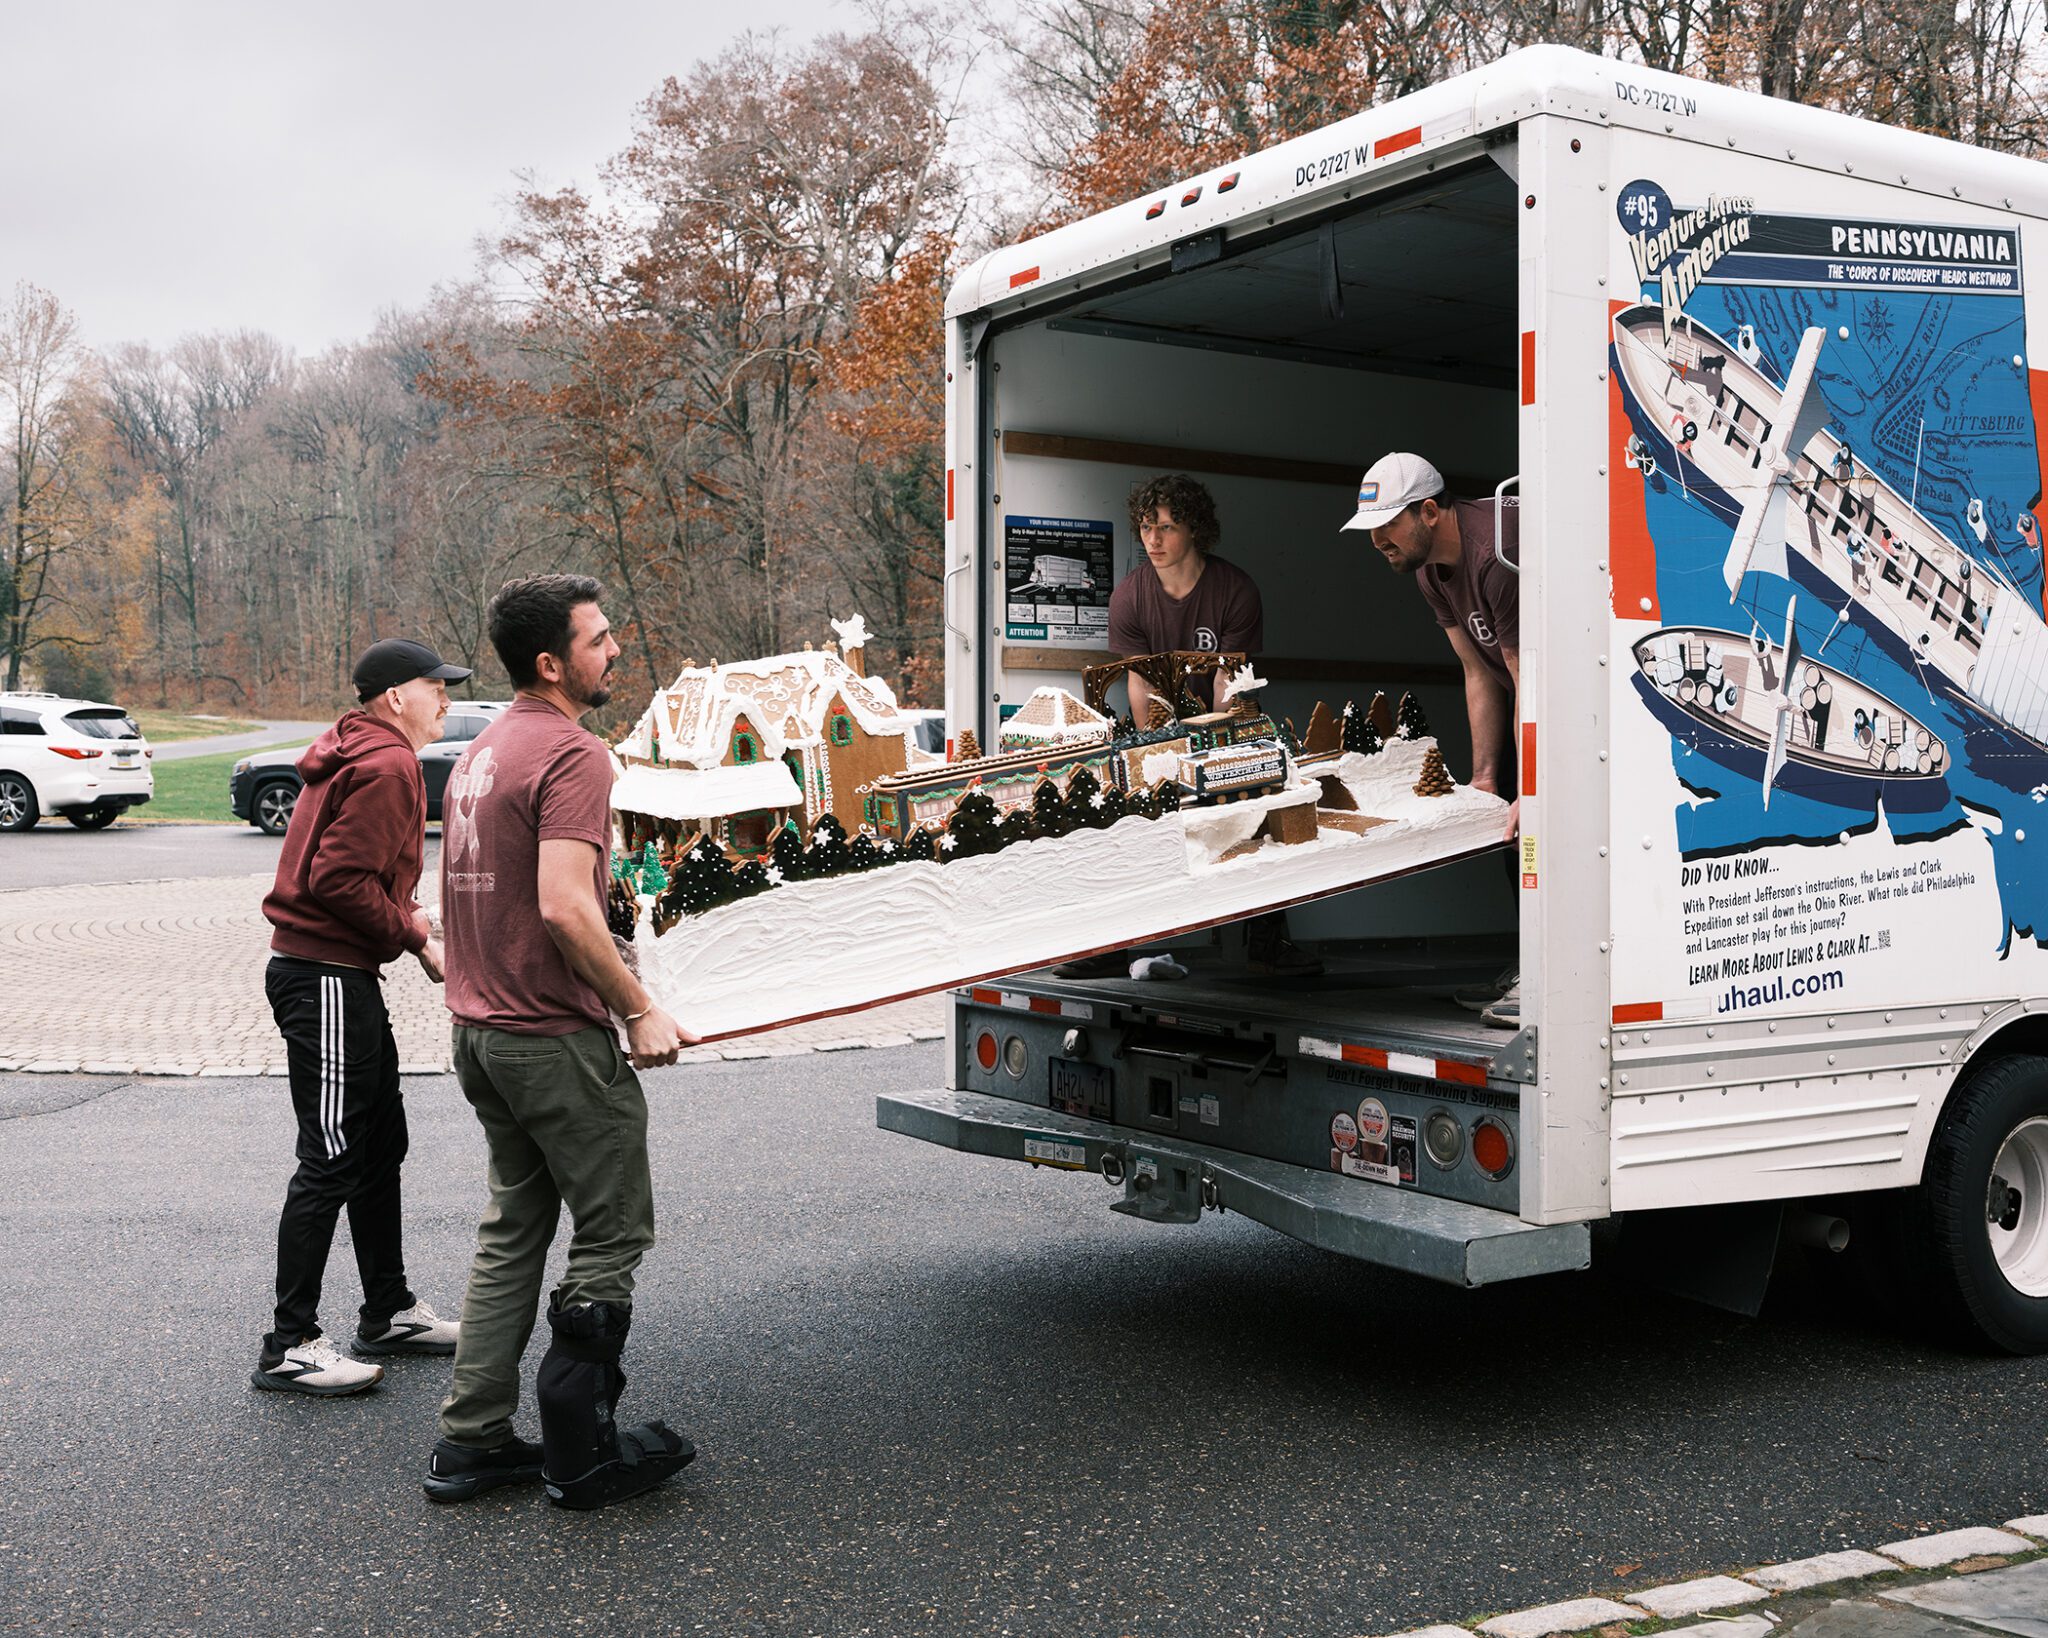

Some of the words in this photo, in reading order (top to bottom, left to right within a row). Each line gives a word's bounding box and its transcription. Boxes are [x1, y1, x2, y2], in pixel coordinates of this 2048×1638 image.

[1615, 81, 1640, 105] DC
[1681, 96, 1697, 117] W
[1296, 163, 1316, 187] DC
[1320, 149, 1351, 179] 2727
[1355, 143, 1369, 166] W
[1624, 194, 1658, 227] #95
[1630, 206, 1706, 284] Venture
[1709, 193, 1755, 222] Across
[1831, 226, 2011, 261] PENNSYLVANIA
[1661, 216, 1750, 344] America
[1828, 264, 1844, 279] THE
[1880, 267, 1890, 282] OF
[1941, 272, 1967, 285] HEADS
[1969, 273, 2012, 286] WESTWARD
[1922, 300, 1943, 345] River
[1942, 416, 2025, 431] PITTSBURG
[1009, 627, 1044, 637] ATTENTION
[1196, 632, 1212, 650] B
[1472, 617, 1492, 640] B
[1681, 866, 1702, 887] DID
[1706, 862, 1730, 883] YOU
[1683, 897, 1706, 915] With
[1709, 892, 1751, 911] President
[1754, 884, 1802, 903] Jefferson's
[1805, 875, 1858, 894] instructions,
[1860, 870, 1874, 885] the
[1876, 866, 1900, 883] Lewis
[1902, 862, 1917, 877] and
[1919, 858, 1942, 875] Clark
[1684, 917, 1733, 936] Expedition
[1736, 912, 1750, 926] set
[1752, 907, 1769, 923] sail
[1772, 905, 1795, 920] down
[1797, 900, 1812, 914] the
[1815, 897, 1836, 912] Ohio
[1839, 893, 1865, 907] River.
[1867, 887, 1890, 902] What
[1893, 883, 1909, 898] role
[1911, 879, 1924, 894] did
[1926, 871, 1976, 892] Philadelphia
[1685, 938, 1702, 955] and
[1705, 931, 1749, 952] Lancaster
[1752, 927, 1771, 946] play
[1774, 924, 1787, 939] for
[1790, 921, 1807, 935] this
[1810, 911, 1846, 935] journey?
[1688, 963, 1719, 986] LEARN
[1721, 957, 1750, 979] MORE
[1752, 949, 1784, 974] ABOUT
[1786, 945, 1813, 968] LEWIS
[1816, 942, 1825, 960] &
[1827, 938, 1856, 960] CLARK
[1717, 969, 1844, 1014] uhaul.com
[1327, 1065, 1355, 1081] Don't
[1358, 1069, 1393, 1090] Forget
[1397, 1078, 1420, 1093] Your
[1424, 1081, 1467, 1103] Moving
[1471, 1087, 1520, 1109] Supplie
